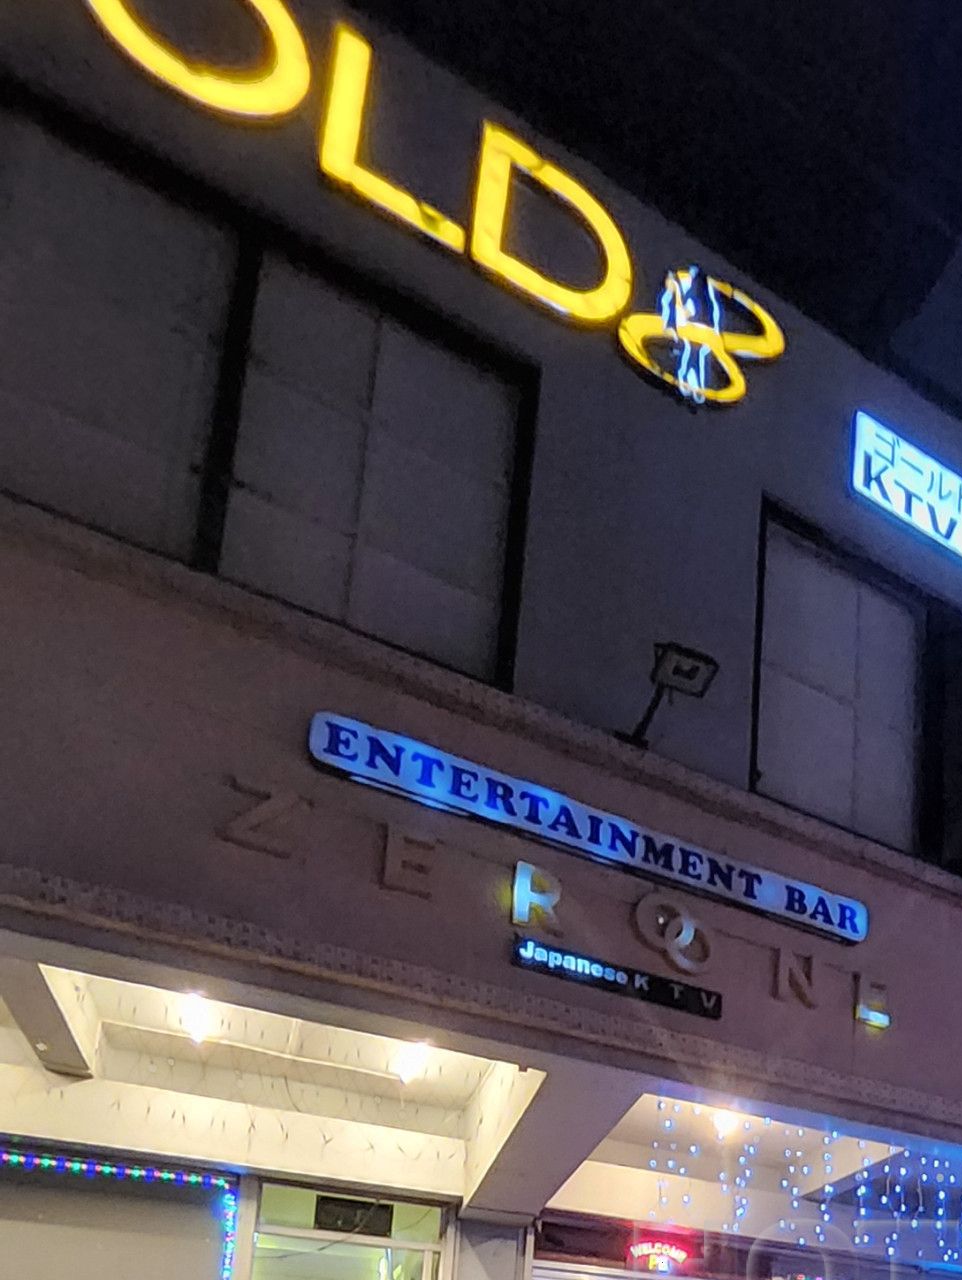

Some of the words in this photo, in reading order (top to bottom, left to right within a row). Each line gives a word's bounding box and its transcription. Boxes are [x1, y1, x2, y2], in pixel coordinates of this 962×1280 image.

[862, 450, 957, 540] KTV
[322, 720, 763, 900] ENTERTAINMENT
[784, 884, 860, 934] BAR
[518, 940, 629, 985] Japanese
